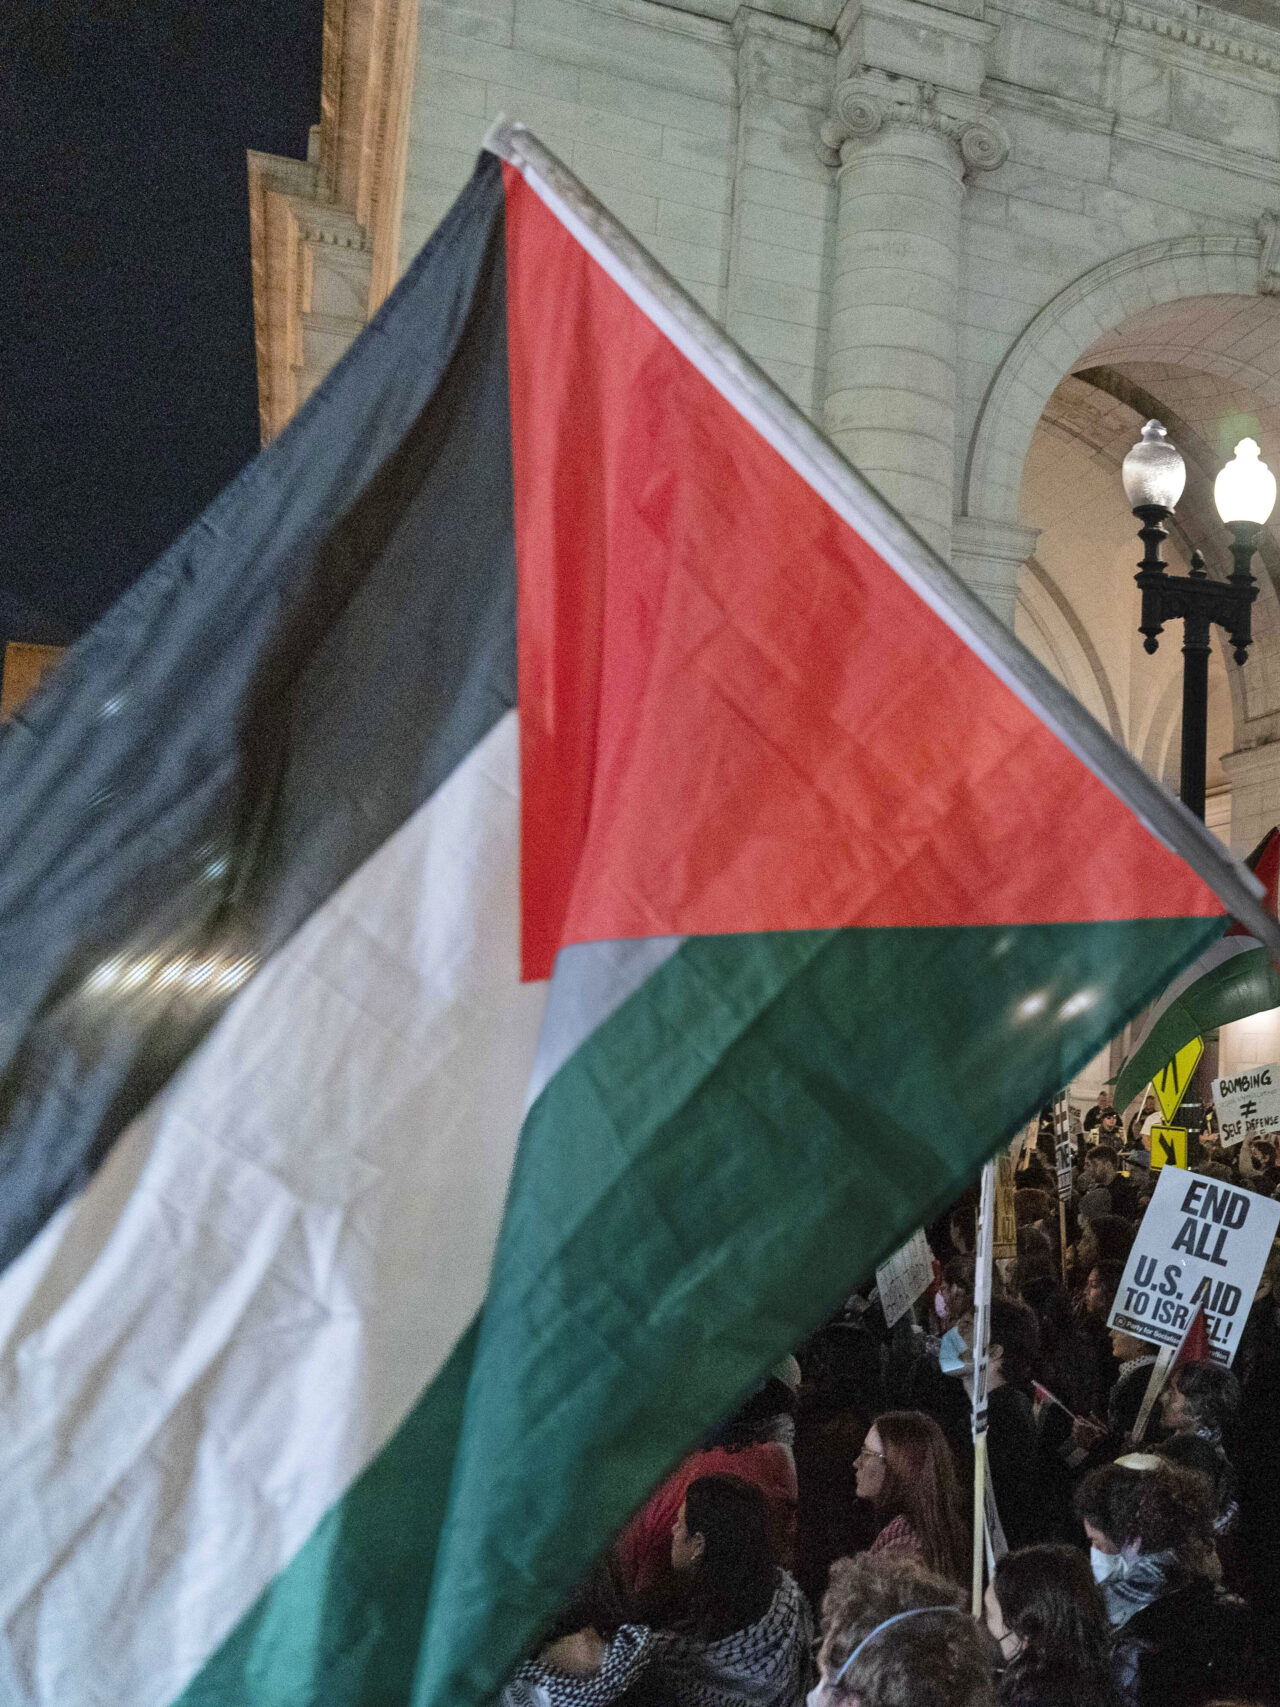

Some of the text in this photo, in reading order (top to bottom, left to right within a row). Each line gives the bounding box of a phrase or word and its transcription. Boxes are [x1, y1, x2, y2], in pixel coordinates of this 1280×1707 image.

[1220, 1069, 1271, 1097] BOMBING
[1222, 1120, 1242, 1141] SELF
[1245, 1115, 1279, 1131] DEFENSE
[1180, 1179, 1250, 1229] END
[1171, 1217, 1229, 1267] ALL
[1133, 1254, 1242, 1317] U.S. AID
[1123, 1287, 1149, 1315] TO
[1126, 1321, 1142, 1333] Party
[1143, 1325, 1153, 1334] for
